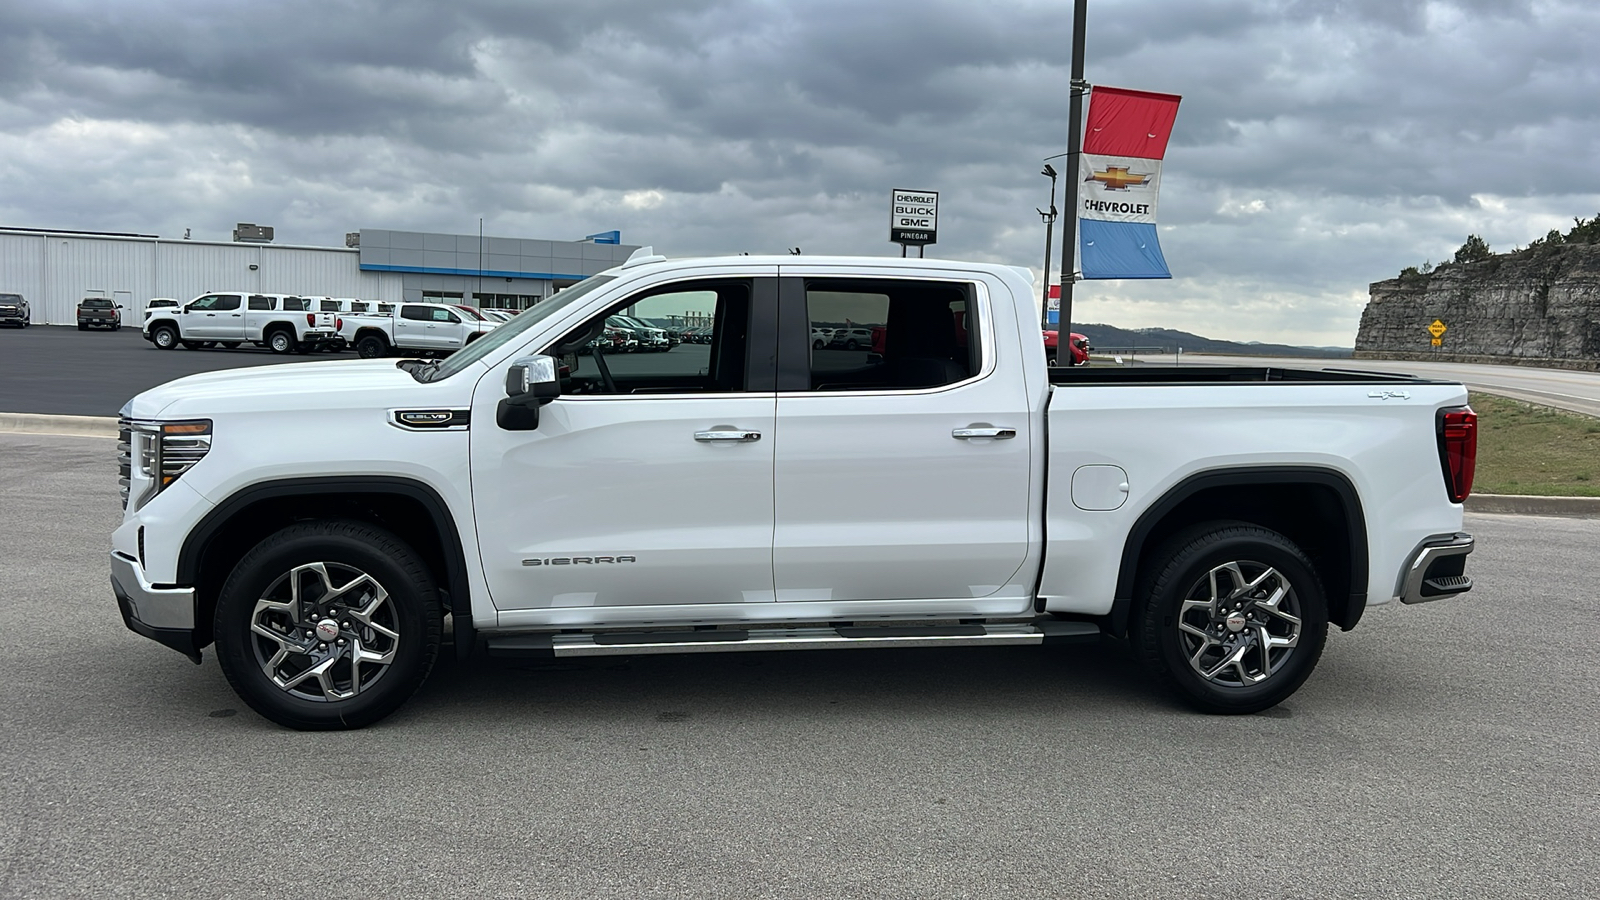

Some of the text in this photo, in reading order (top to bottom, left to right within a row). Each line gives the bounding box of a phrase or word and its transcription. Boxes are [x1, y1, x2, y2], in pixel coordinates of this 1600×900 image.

[897, 195, 935, 203] CHEVROLET
[895, 206, 934, 215] BUICK
[1084, 199, 1149, 214] CHEVROLET
[900, 218, 929, 227] GMC
[900, 232, 928, 240] PINEGAR
[522, 555, 636, 566] SIERRA
